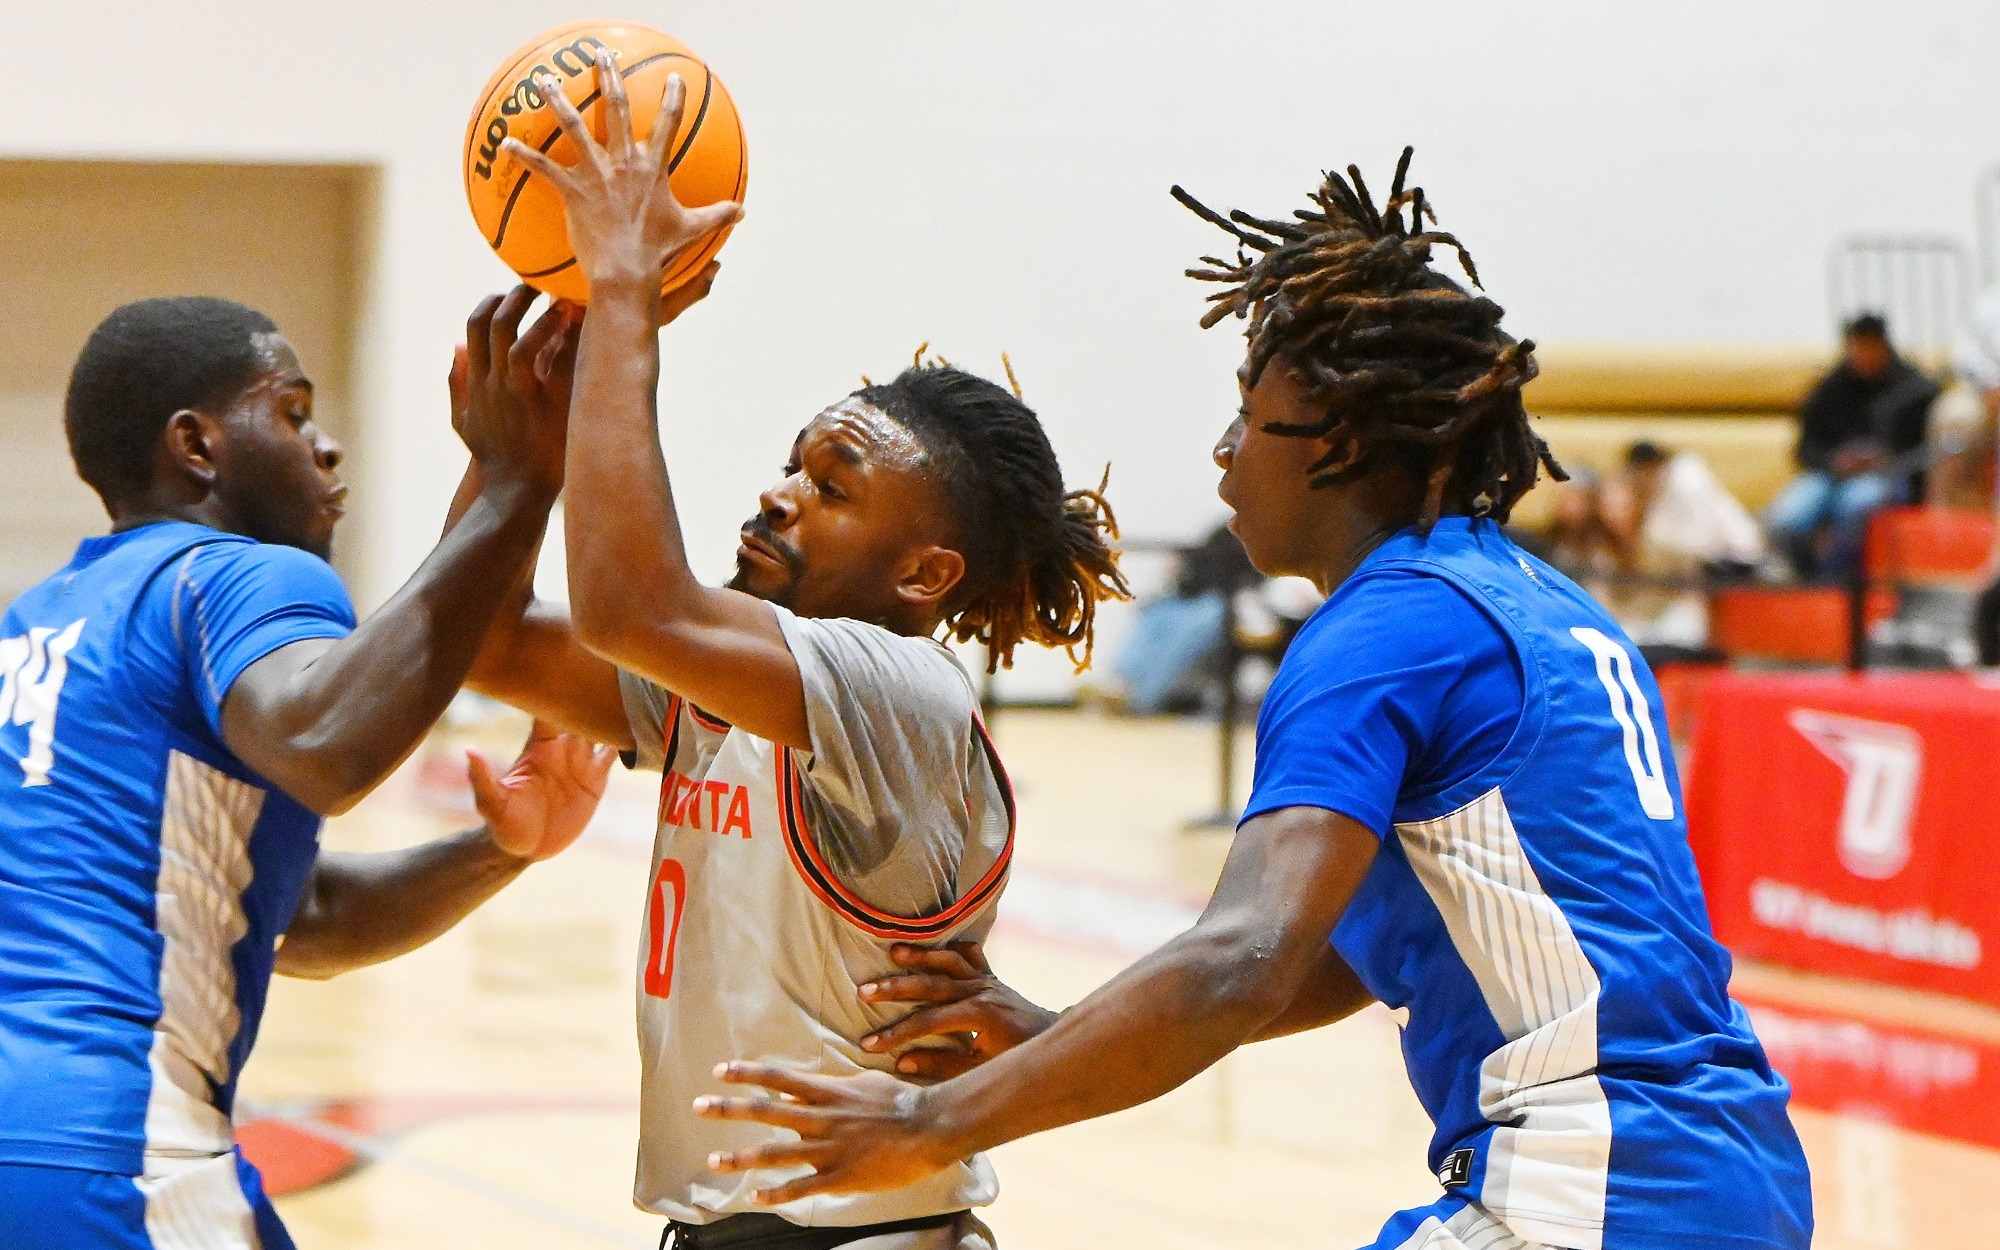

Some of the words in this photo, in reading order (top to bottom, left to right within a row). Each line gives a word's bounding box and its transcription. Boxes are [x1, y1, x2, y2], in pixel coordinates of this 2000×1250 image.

[475, 36, 621, 181] Wilson
[1569, 626, 1674, 820] 0
[644, 858, 686, 999] 0
